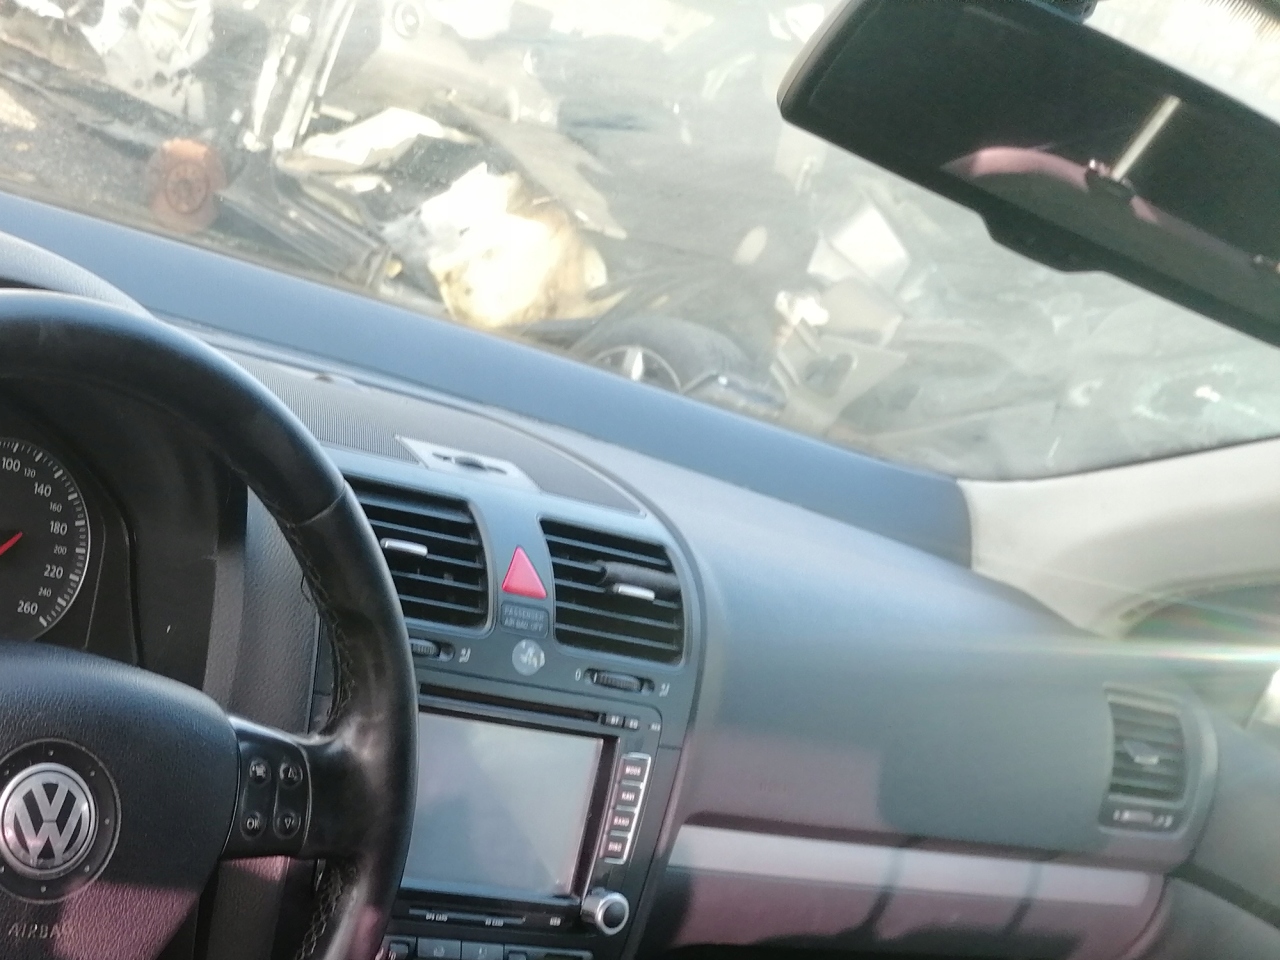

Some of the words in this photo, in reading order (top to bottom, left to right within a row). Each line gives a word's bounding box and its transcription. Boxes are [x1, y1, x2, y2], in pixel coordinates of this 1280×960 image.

[1, 457, 20, 472] 100
[34, 482, 52, 497] 140
[49, 501, 63, 513] 160
[49, 520, 68, 536] 180
[53, 545, 67, 555] 200
[44, 564, 64, 579] 220
[38, 587, 52, 598] 240
[17, 599, 38, 615] 260
[246, 817, 260, 830] OK
[8, 922, 73, 939] AIRBA
